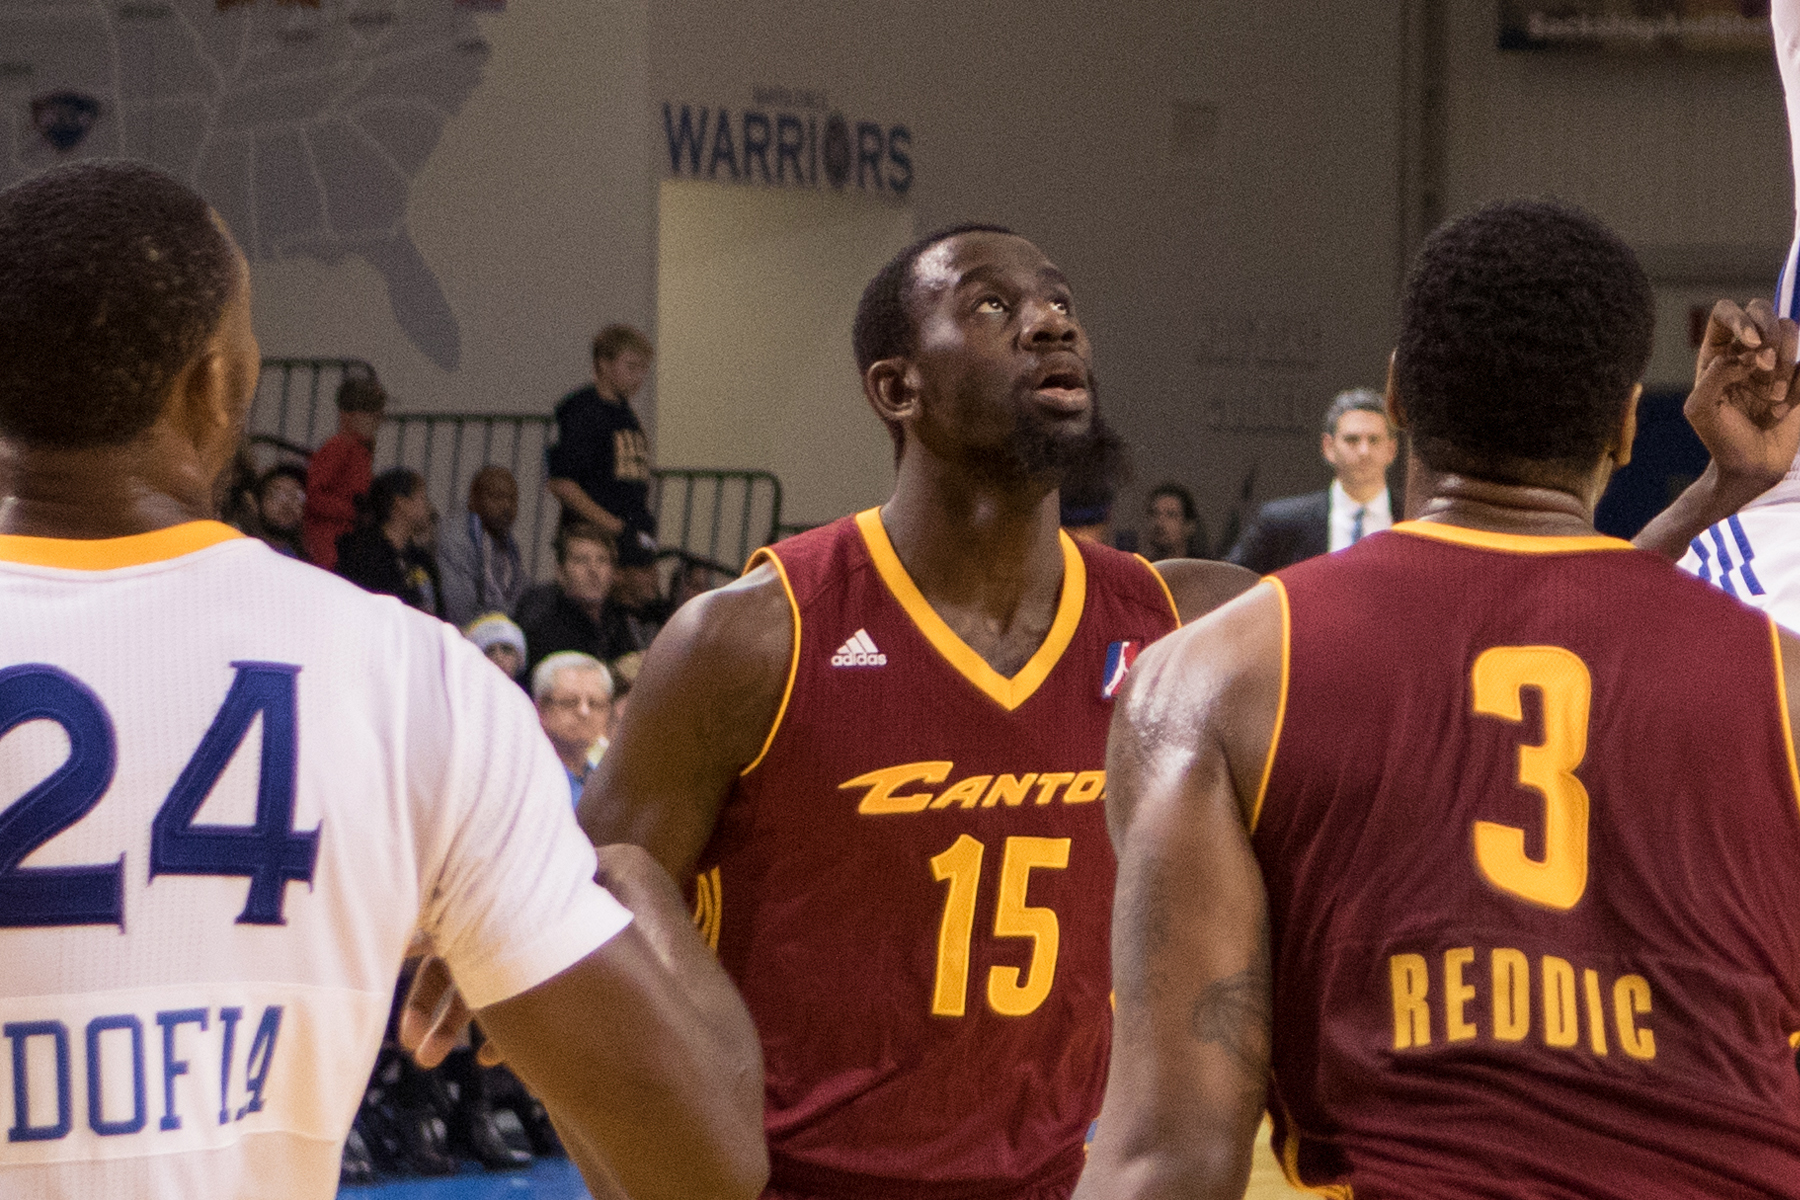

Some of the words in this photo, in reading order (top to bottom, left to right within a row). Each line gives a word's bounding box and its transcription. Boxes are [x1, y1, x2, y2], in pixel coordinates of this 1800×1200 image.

[662, 102, 914, 197] WARRIORS
[830, 650, 888, 668] adidas
[0, 660, 323, 935] 24
[838, 760, 1107, 816] CANTO
[1471, 643, 1593, 912] 3
[929, 833, 1072, 1017] 15
[1389, 945, 1658, 1061] REDDIC
